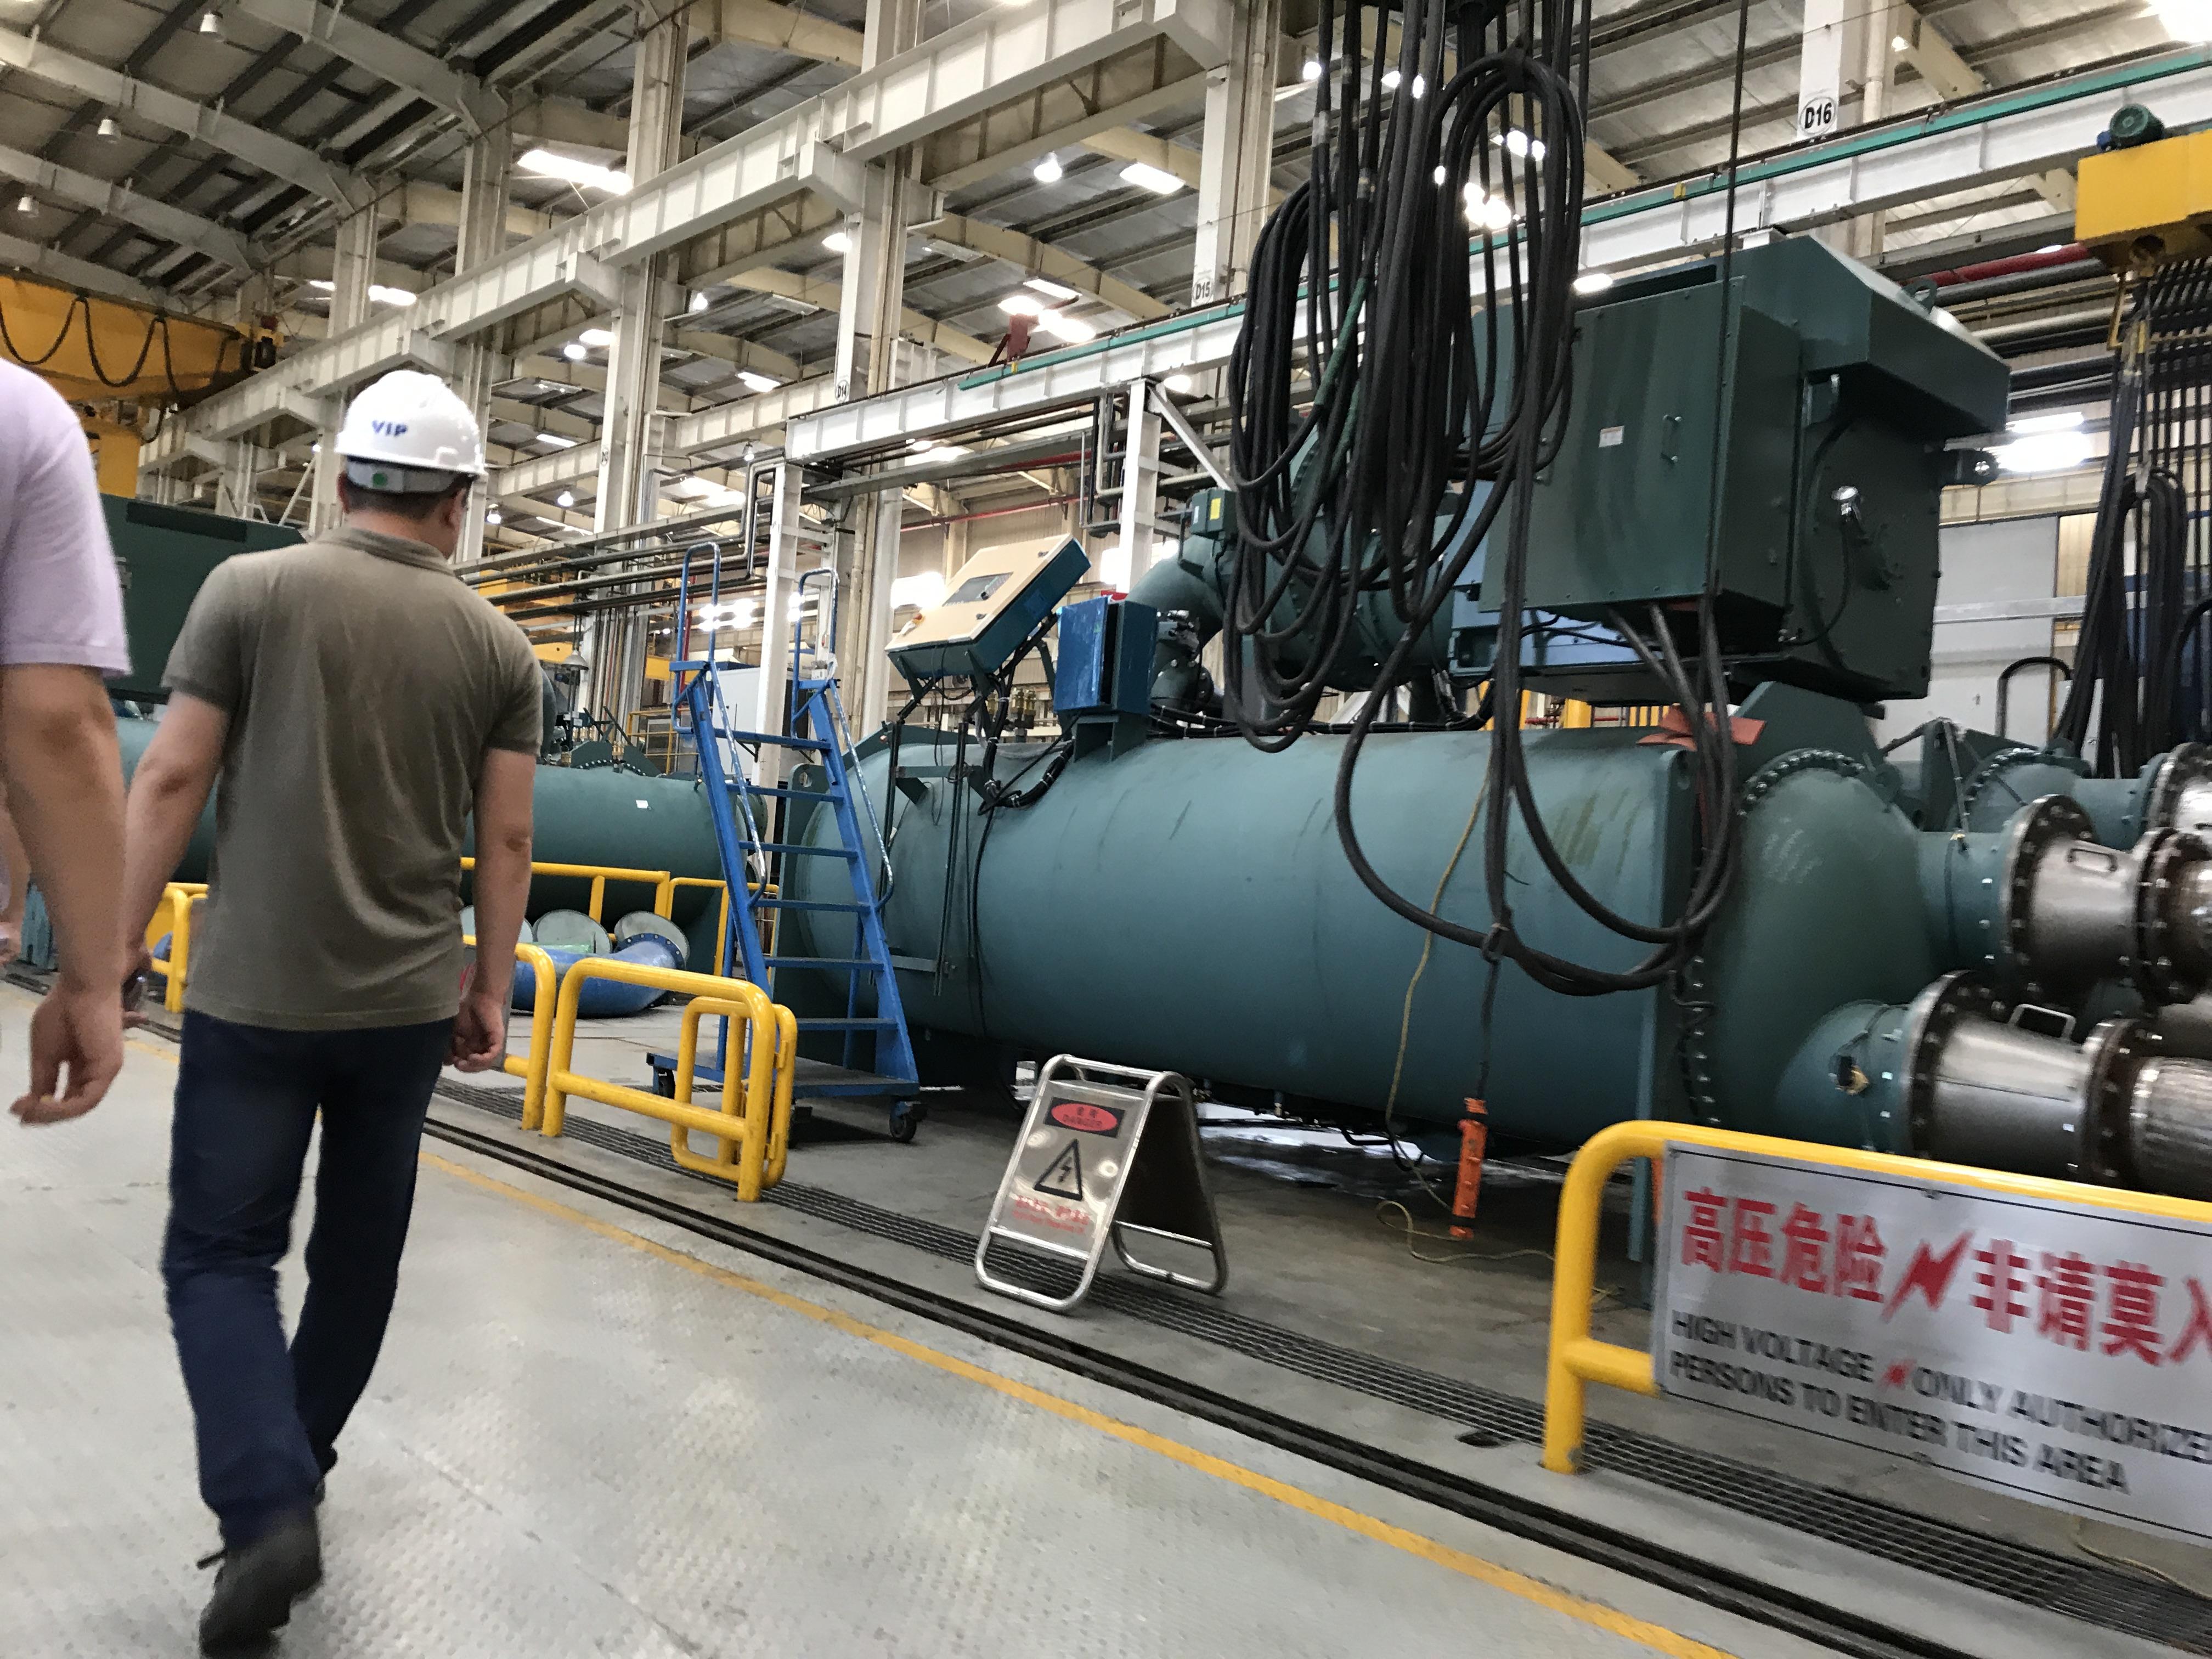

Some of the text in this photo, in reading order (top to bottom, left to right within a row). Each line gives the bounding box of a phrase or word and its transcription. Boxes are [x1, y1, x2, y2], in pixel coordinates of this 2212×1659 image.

[1804, 103, 1832, 129] D16
[1195, 281, 1210, 300] D15
[837, 385, 847, 398] D14
[372, 420, 408, 437] VIP
[1683, 1187, 1886, 1304] 高压危险
[1672, 1310, 1737, 1350] HIGH
[1741, 1325, 1874, 1383] VOLTAGE
[1912, 1366, 2004, 1414] ONLY
[1669, 1350, 2131, 1496] PERSONS TO ENTER THIS AREA
